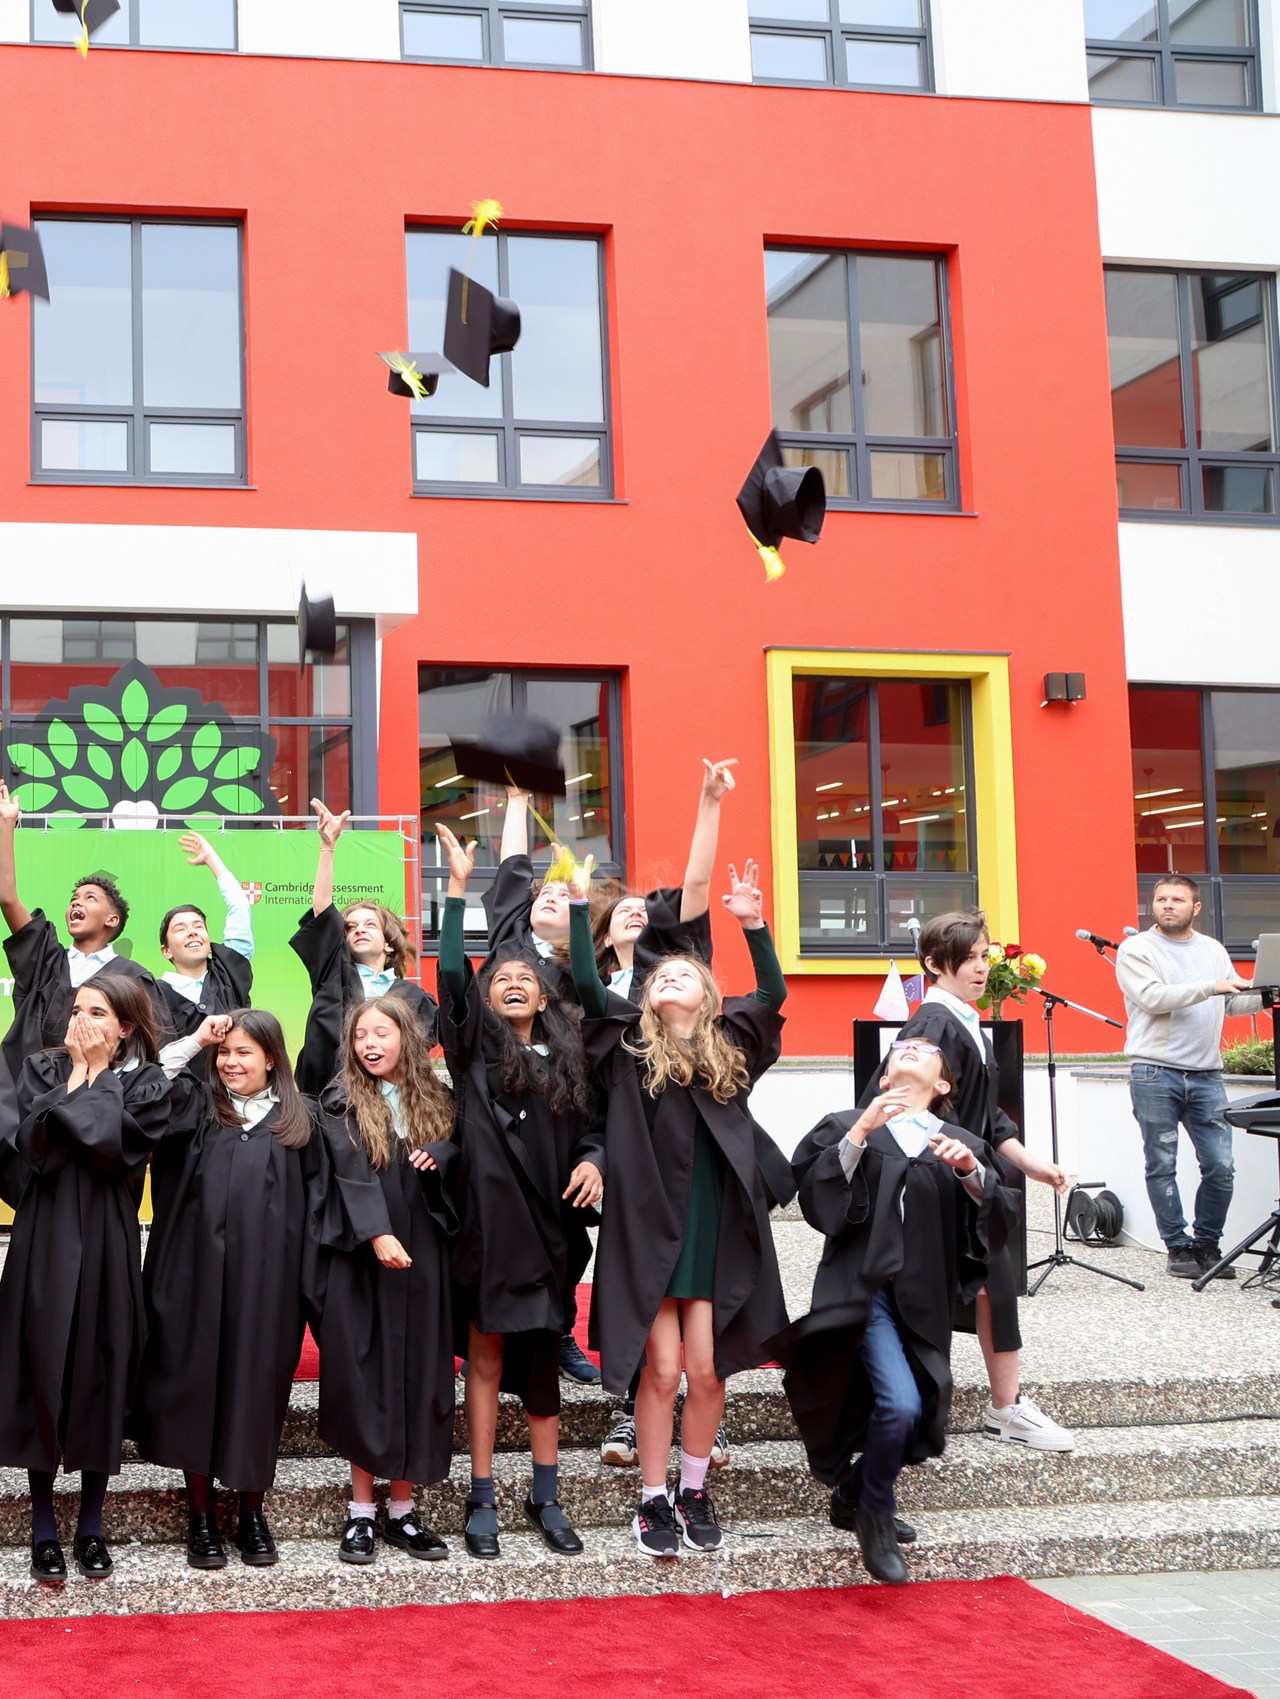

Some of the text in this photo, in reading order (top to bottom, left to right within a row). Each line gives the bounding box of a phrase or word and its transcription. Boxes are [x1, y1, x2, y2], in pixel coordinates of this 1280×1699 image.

[265, 882, 384, 895] Cambridg ssessment
[265, 895, 313, 905] Internatio
